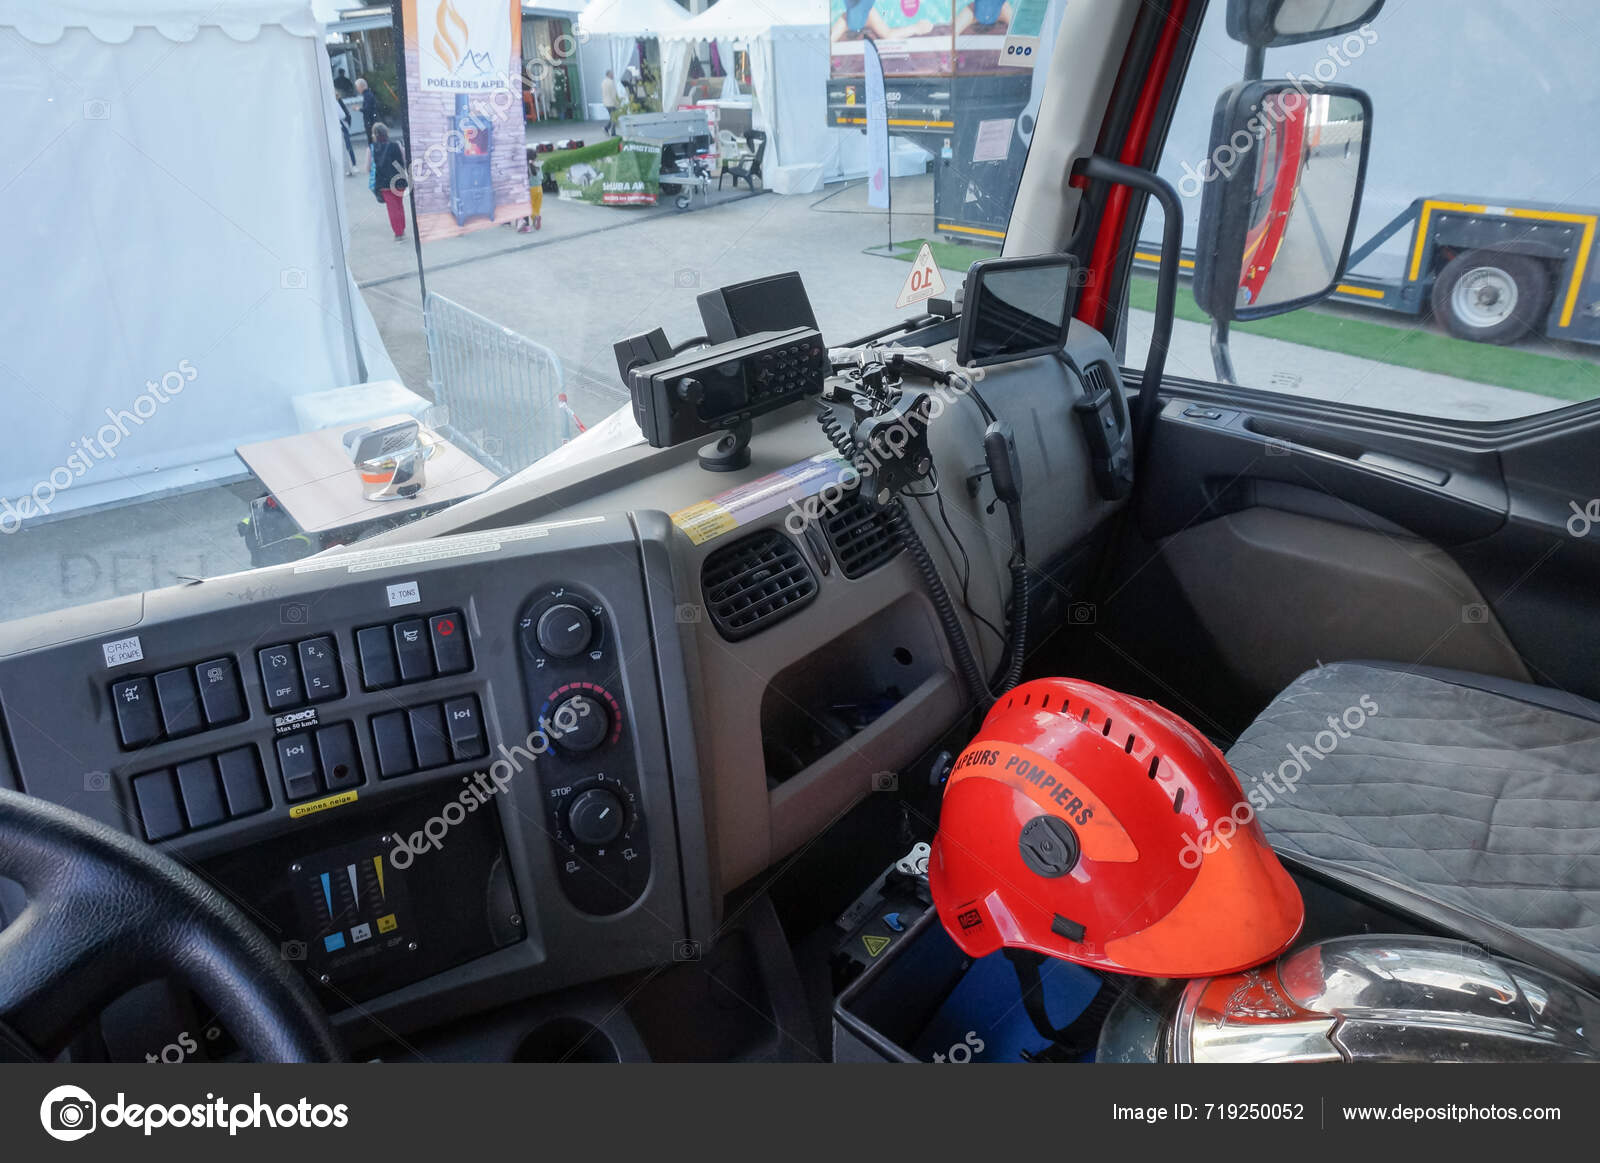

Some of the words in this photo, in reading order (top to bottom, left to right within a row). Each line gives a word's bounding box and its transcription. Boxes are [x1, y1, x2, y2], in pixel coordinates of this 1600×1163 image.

[463, 80, 478, 89] DES
[399, 588, 416, 599] TONS
[106, 640, 137, 654] CRAN
[276, 687, 291, 697] OFF
[276, 724, 291, 734] Max
[301, 719, 318, 728] km/h
[550, 786, 572, 798] STOP
[1004, 755, 1094, 826] POMPIERS
